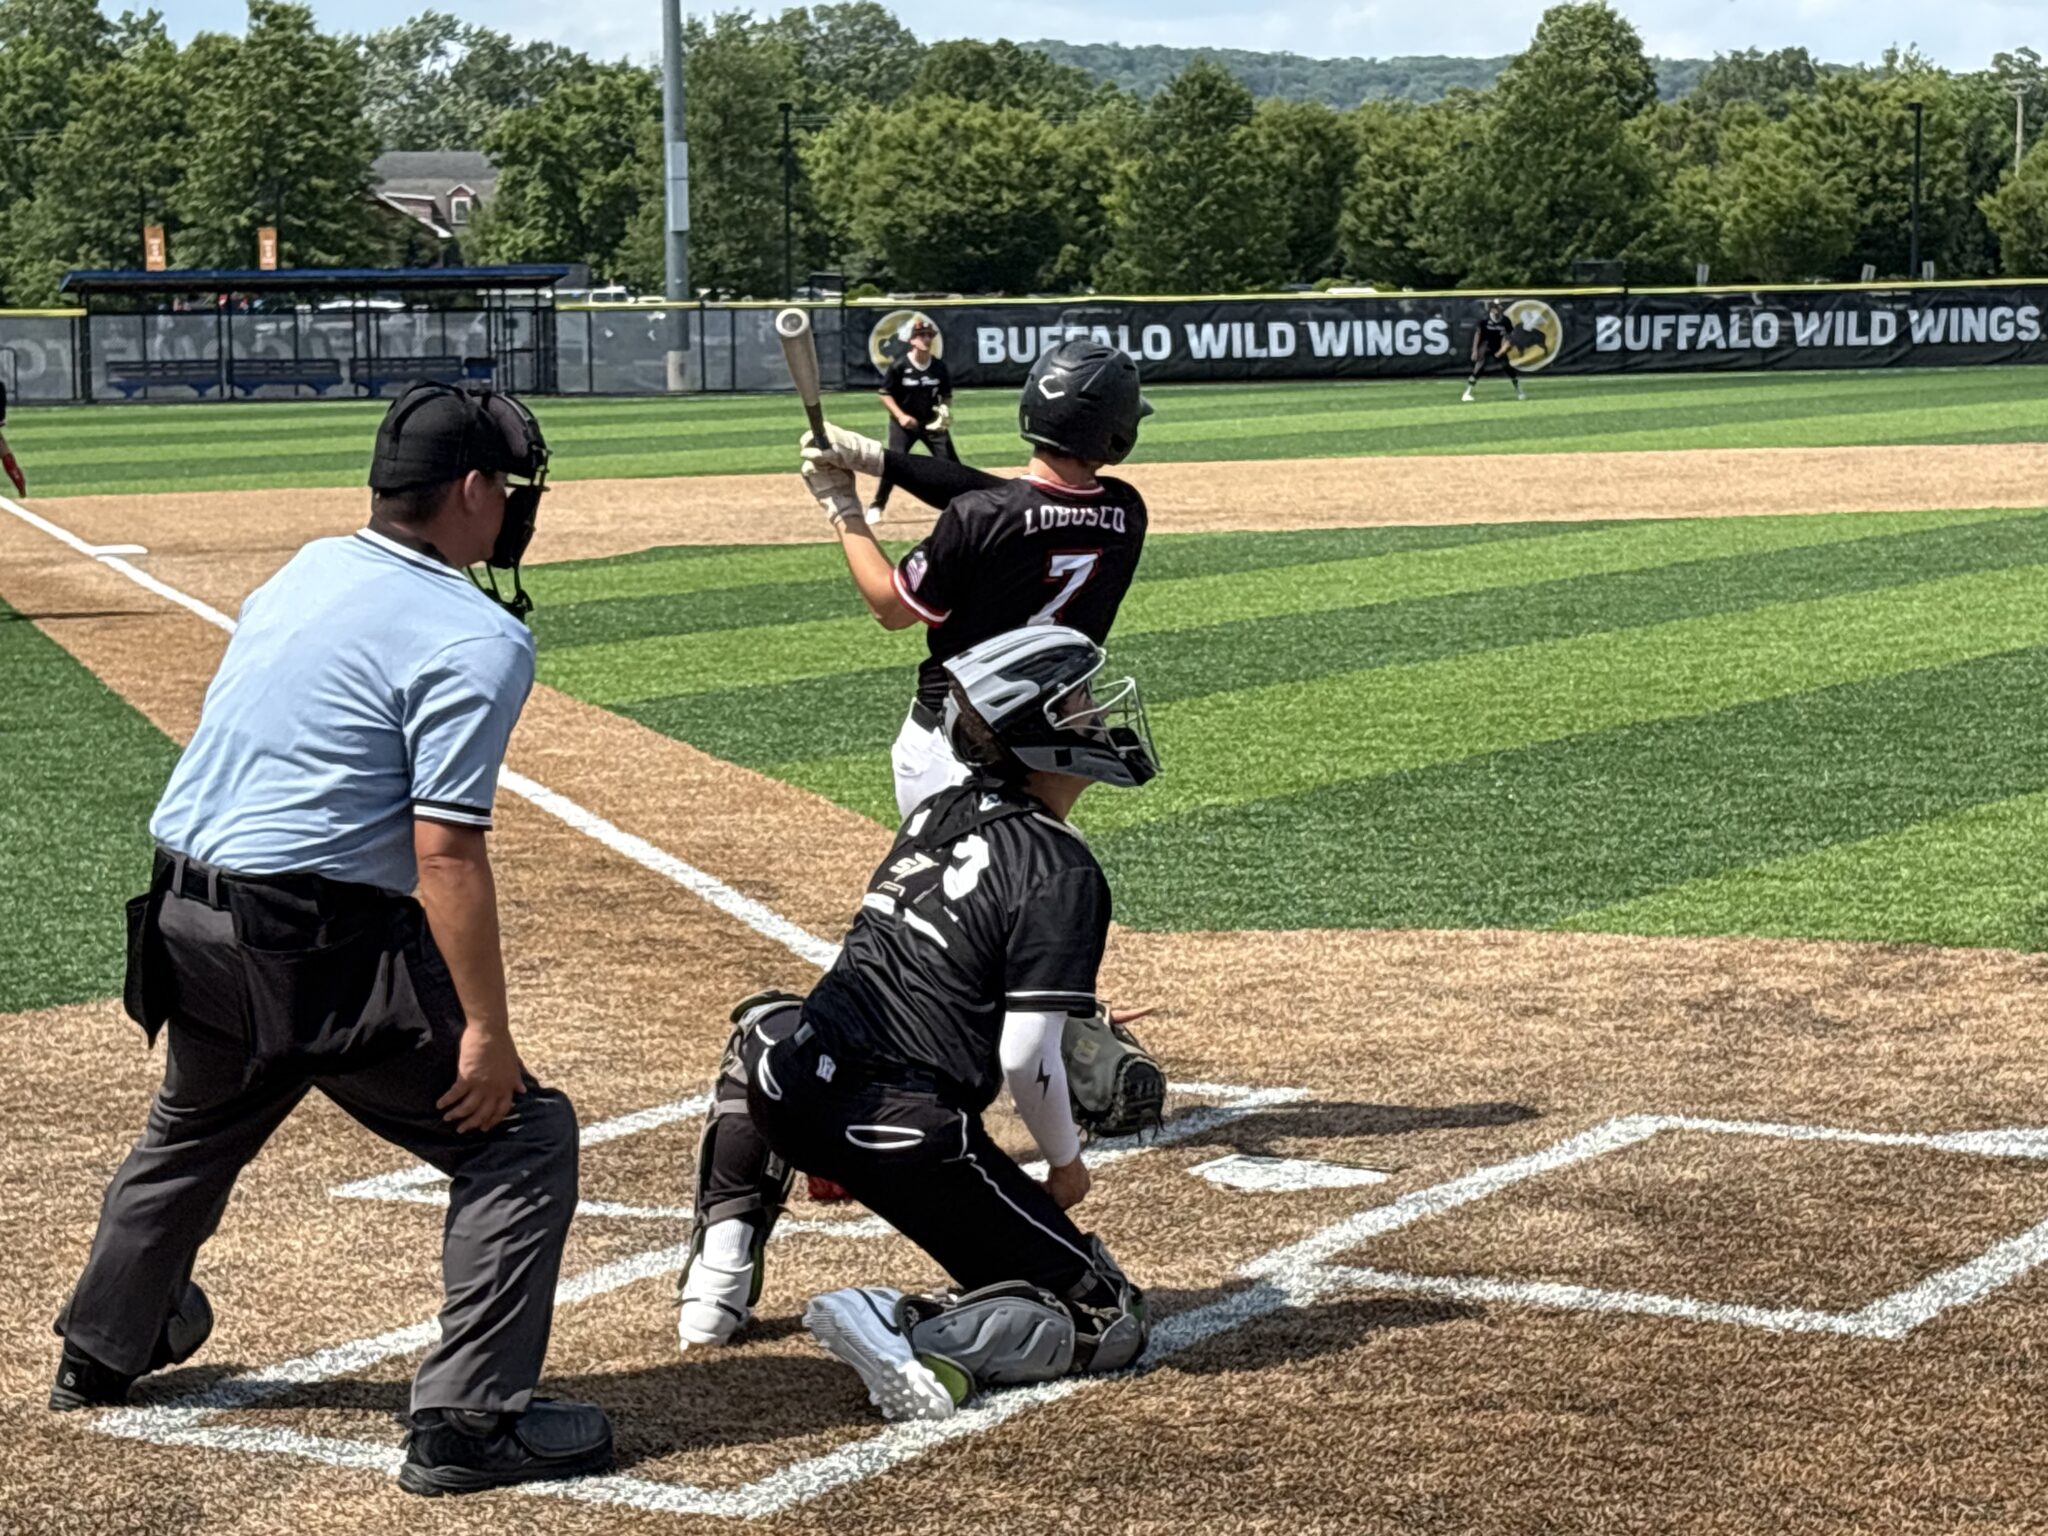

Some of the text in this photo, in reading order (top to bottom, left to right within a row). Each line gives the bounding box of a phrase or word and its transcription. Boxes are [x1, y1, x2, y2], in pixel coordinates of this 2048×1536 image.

[1184, 321, 1297, 360] WILD
[1307, 318, 1450, 357] WINGS
[1595, 305, 2041, 352] BUFFALO WILD WINGS
[1026, 552, 1099, 627] 7
